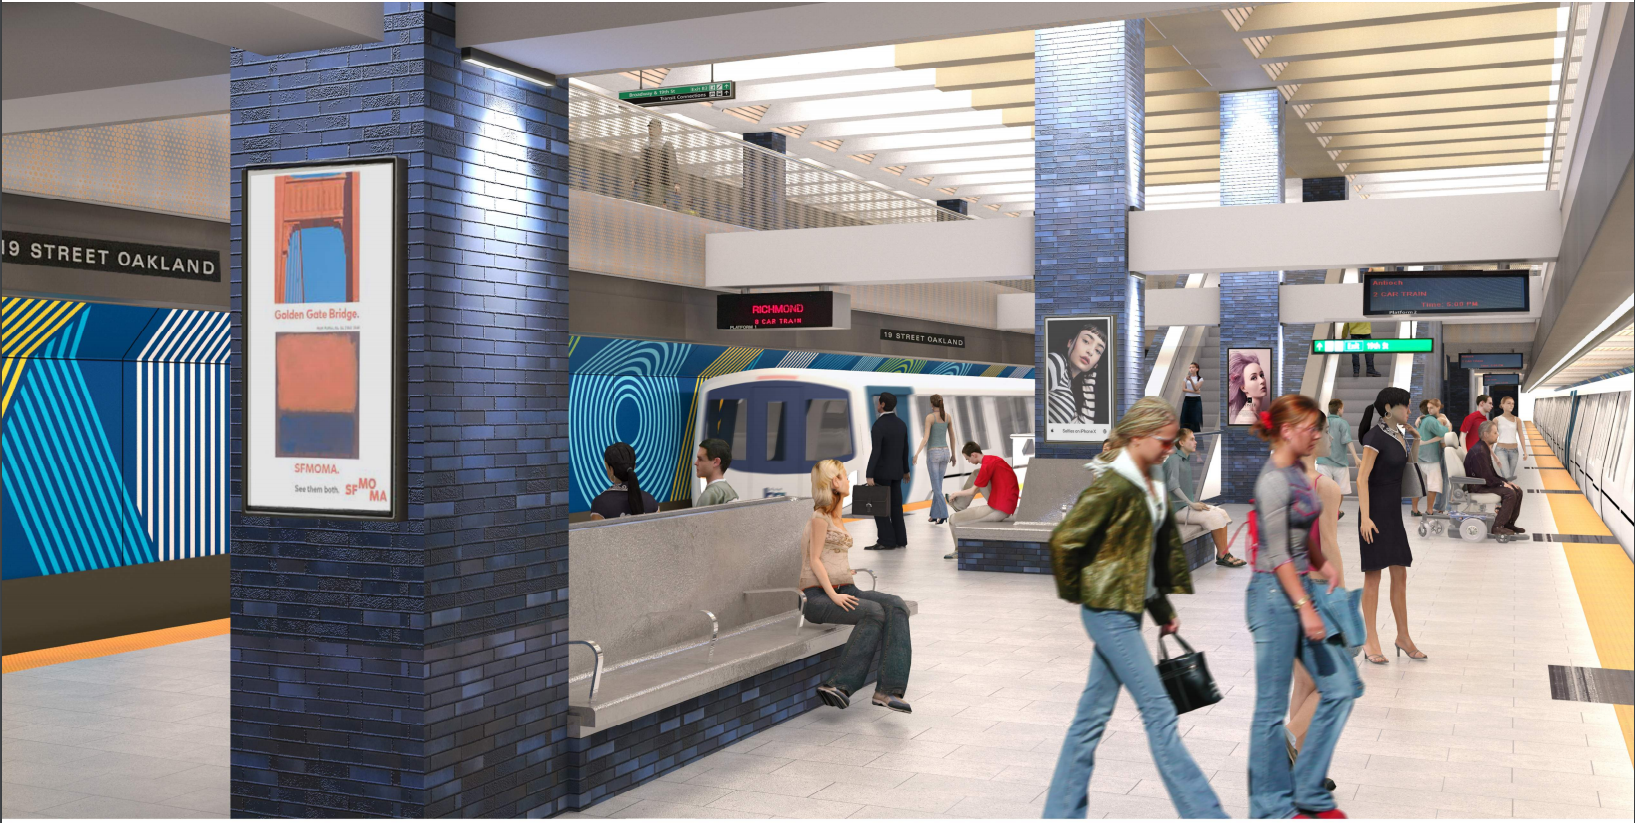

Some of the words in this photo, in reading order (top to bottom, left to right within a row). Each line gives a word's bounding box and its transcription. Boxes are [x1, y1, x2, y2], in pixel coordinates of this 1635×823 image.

[30, 243, 109, 265] STREET
[118, 252, 215, 275] OAKLAND
[274, 309, 304, 320] Golden
[306, 309, 327, 319] Gate
[329, 308, 360, 321] Bridge.
[752, 304, 804, 314] RICHMOND
[896, 332, 925, 341] STREET
[927, 336, 963, 346] OAKLAND
[294, 463, 339, 474] SFMOMA.
[295, 485, 306, 493] See
[345, 484, 358, 495] SF
[358, 478, 376, 489] MO
[369, 490, 387, 502] MA
